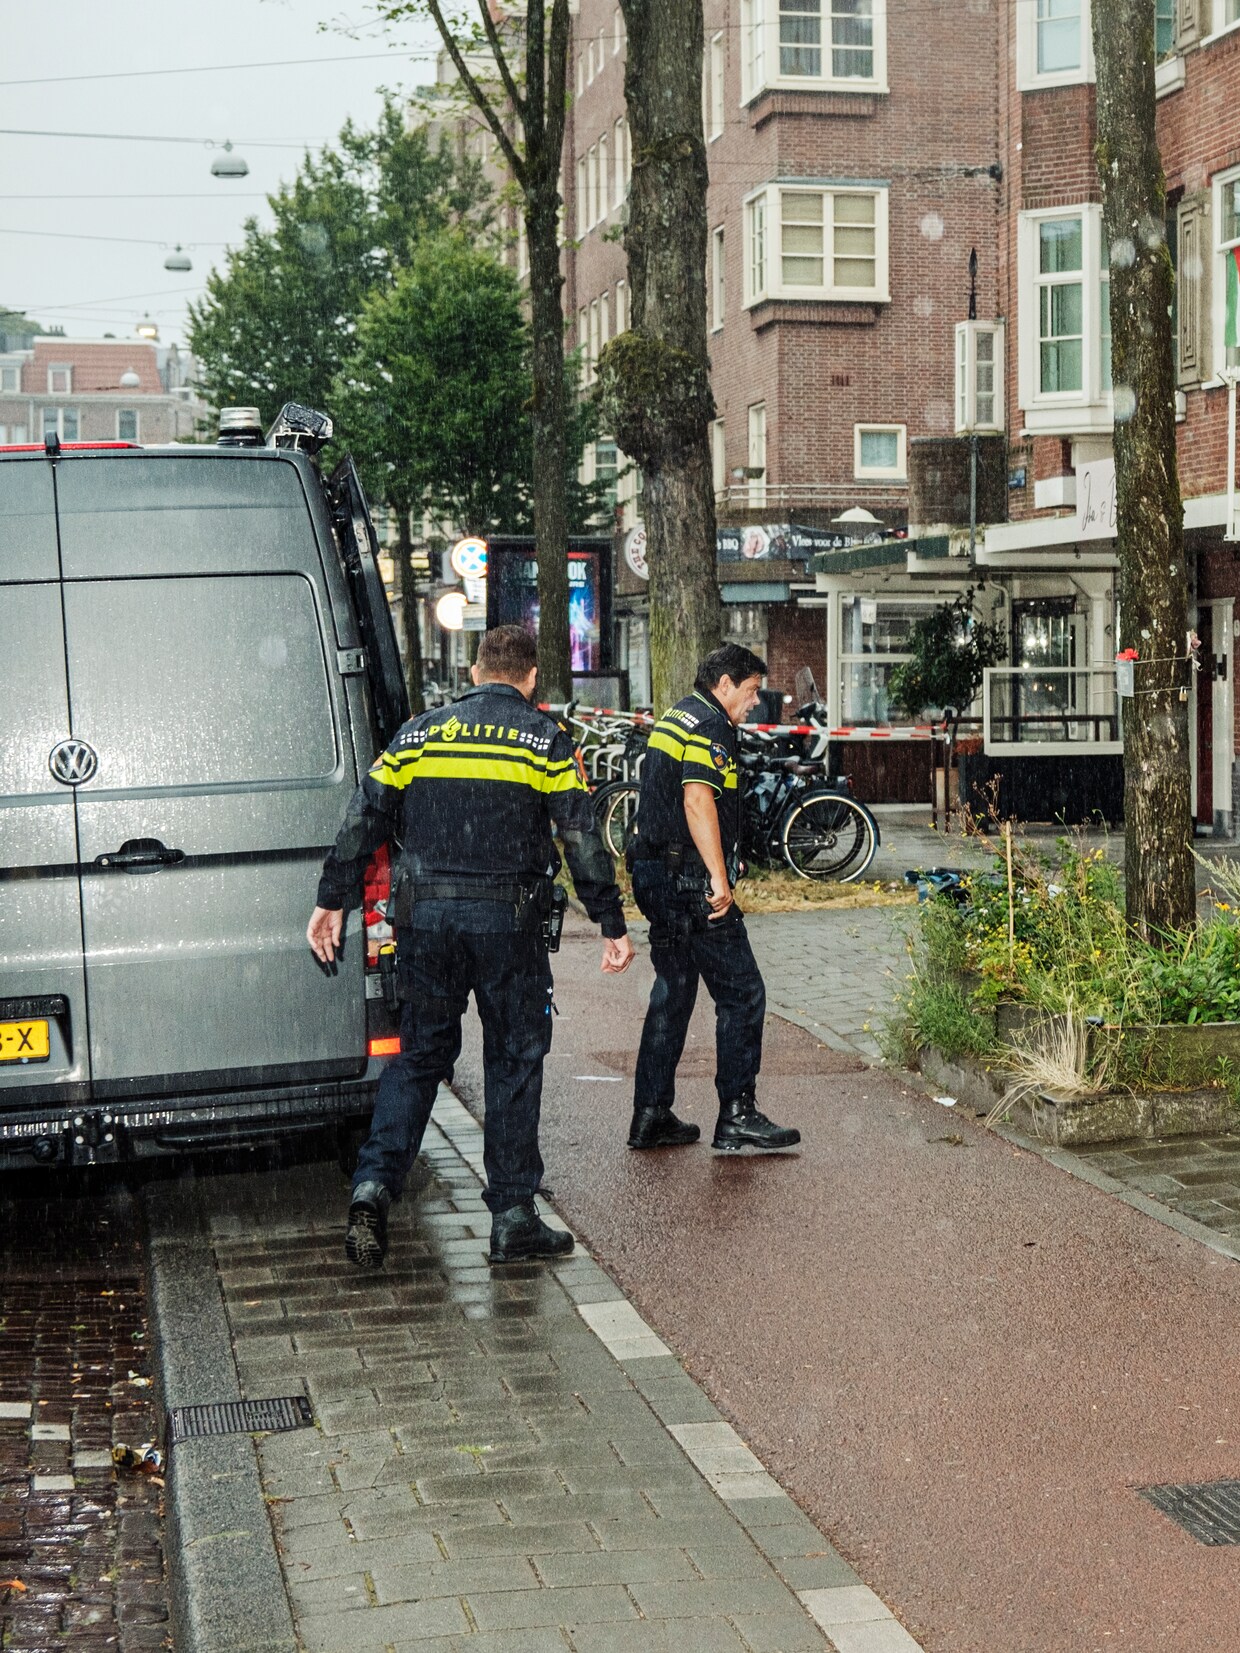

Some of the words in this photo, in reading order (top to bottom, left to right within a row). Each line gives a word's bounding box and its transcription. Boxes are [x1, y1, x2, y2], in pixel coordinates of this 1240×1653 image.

[722, 538, 739, 551] BBQ
[791, 534, 813, 547] Vlees
[814, 538, 831, 548] voor
[833, 535, 843, 548] de
[428, 722, 520, 742] POLITIE
[0, 1027, 35, 1052] -X
